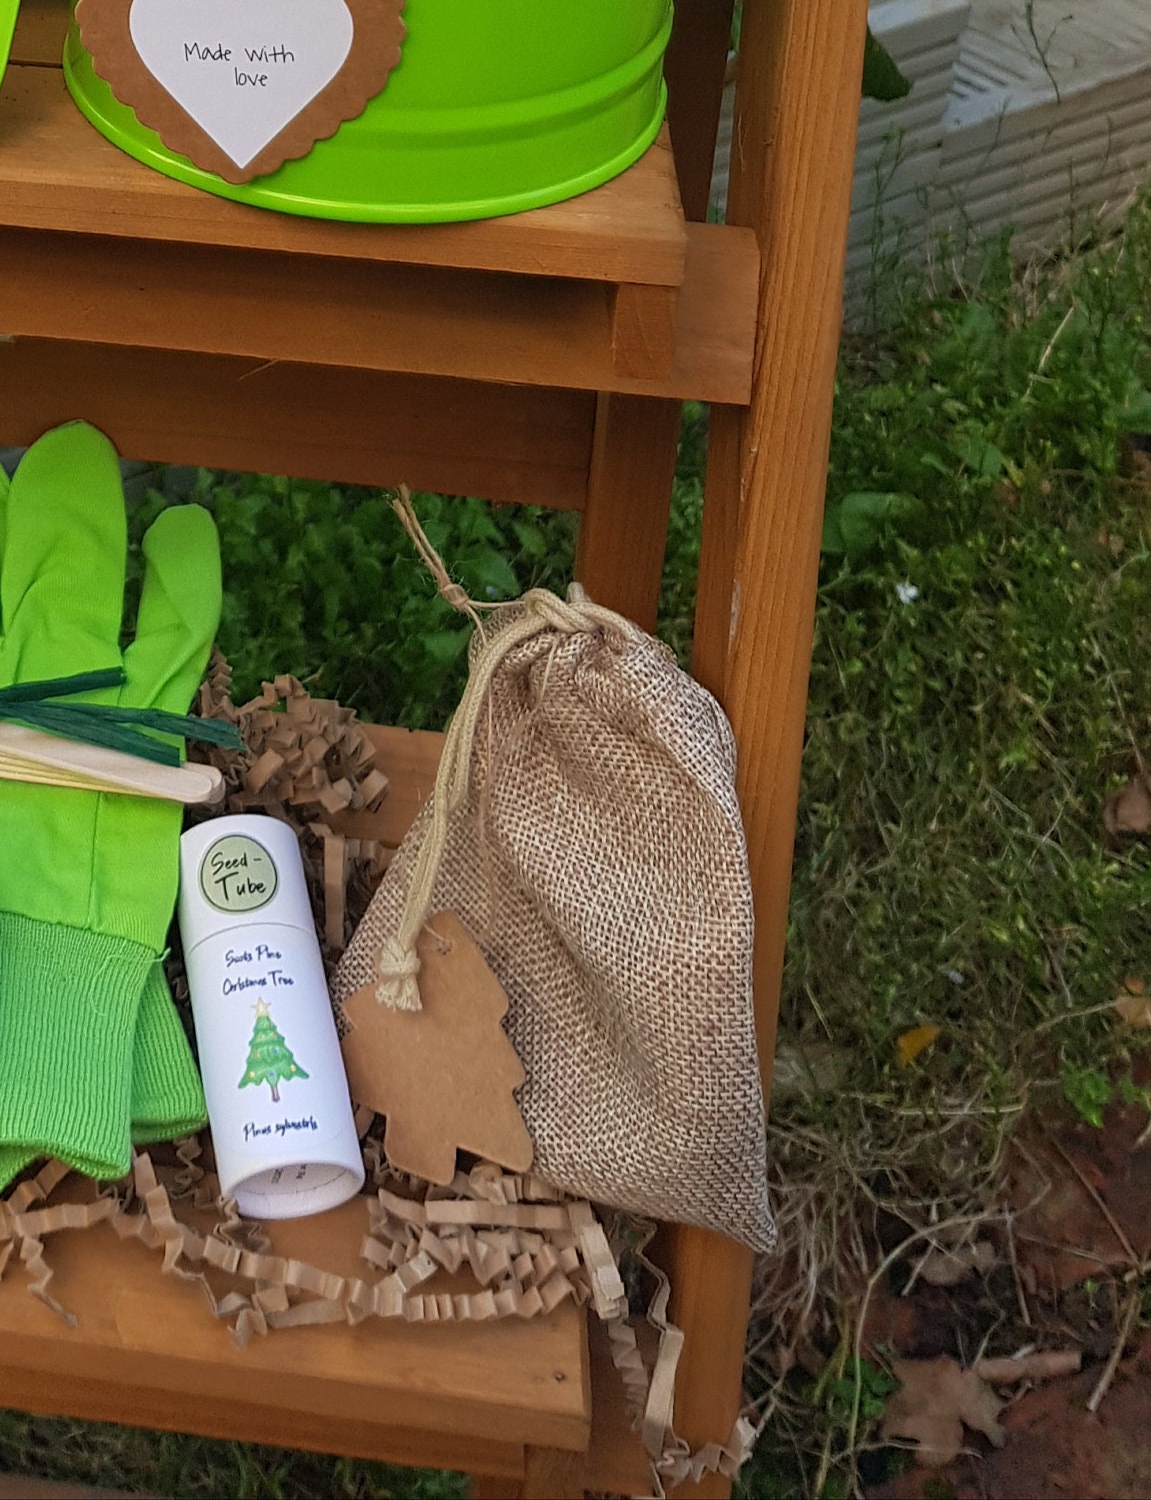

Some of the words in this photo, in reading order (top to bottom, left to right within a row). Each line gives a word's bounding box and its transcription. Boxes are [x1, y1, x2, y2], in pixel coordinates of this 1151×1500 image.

[184, 42, 232, 62] Made
[234, 67, 268, 87] love
[215, 873, 267, 902] Tube
